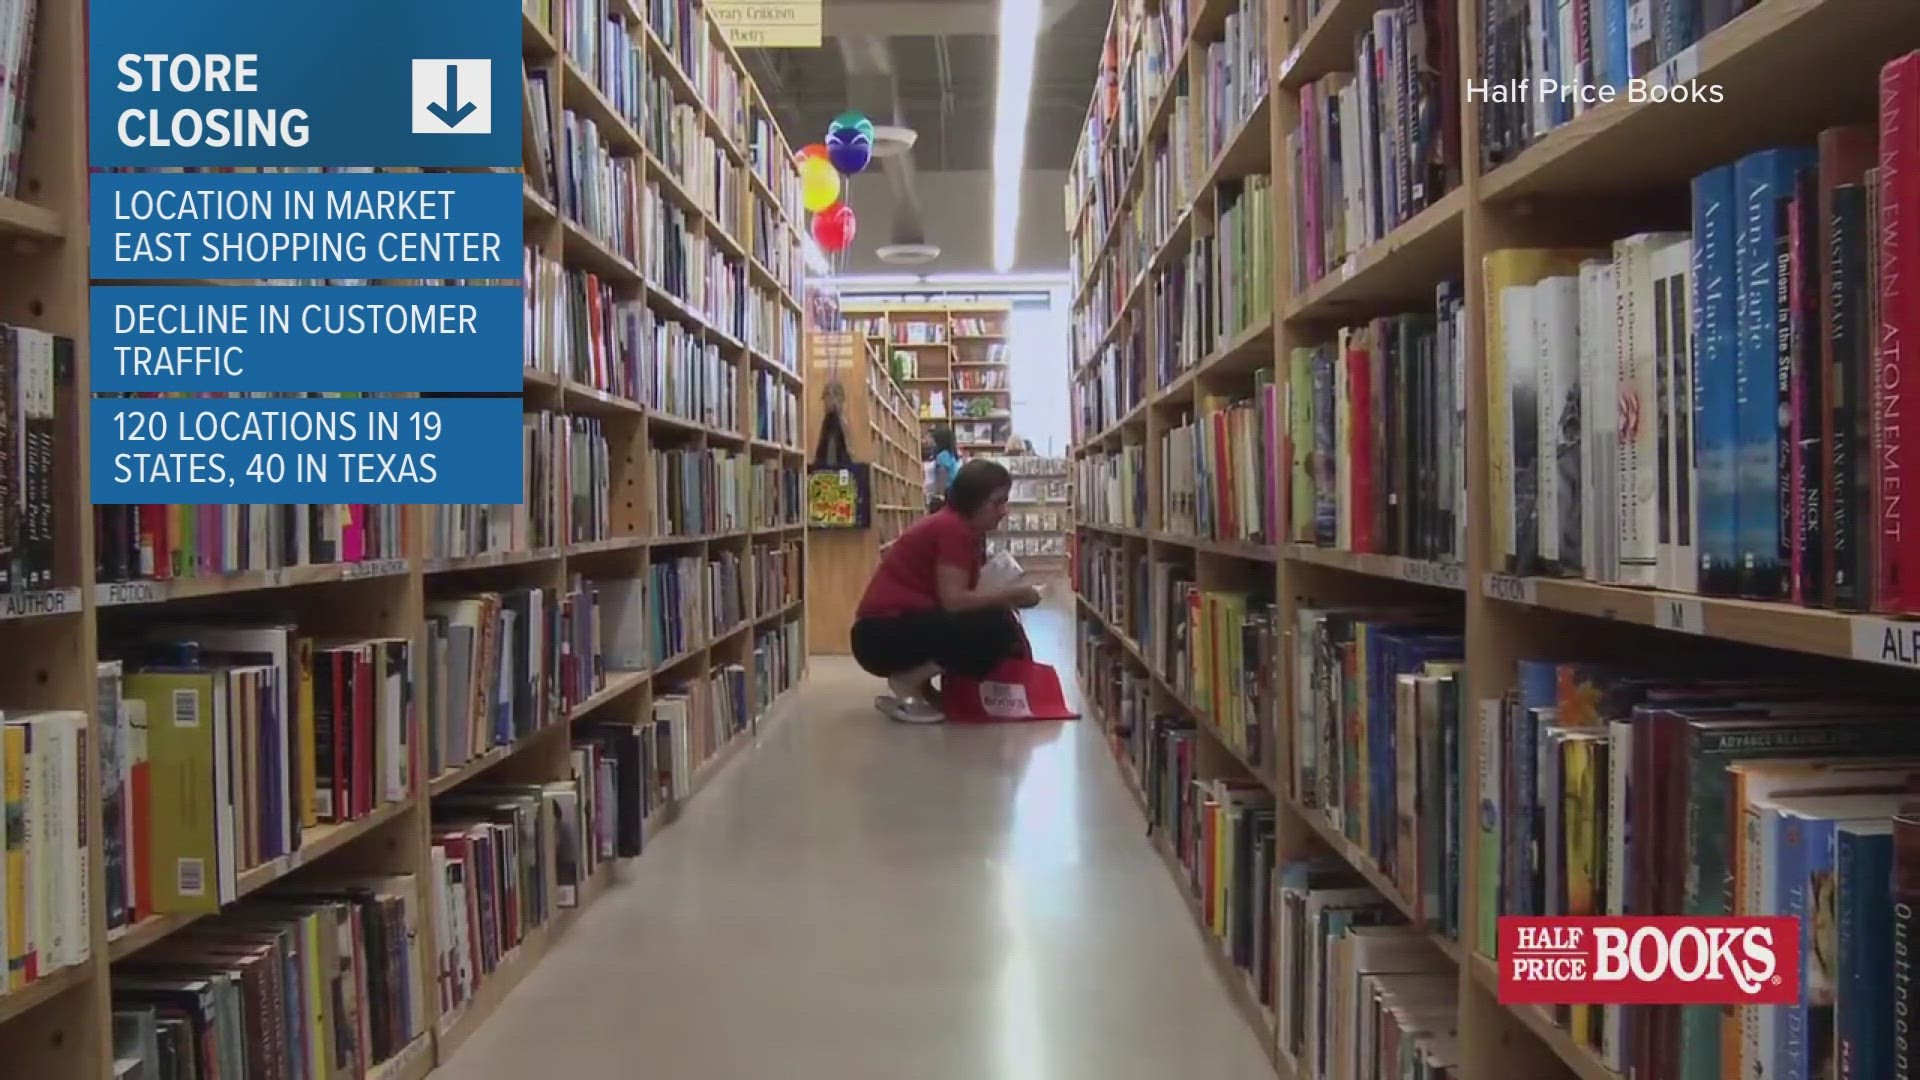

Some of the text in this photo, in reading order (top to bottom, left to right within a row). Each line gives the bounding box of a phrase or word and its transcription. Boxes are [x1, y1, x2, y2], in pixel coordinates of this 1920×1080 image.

[730, 28, 765, 43] Poetry
[1706, 202, 1722, 361] Ann-Marie
[1749, 183, 1770, 350] Ann-Marie
[1832, 213, 1844, 341] AMSTERDAM
[1778, 252, 1791, 393] Onions in the Stew
[1883, 323, 1901, 542] ATONEMENT
[1808, 487, 1819, 531] NICK
[6, 593, 65, 615] AUTHOR
[109, 583, 153, 602] FICTION
[1490, 576, 1525, 600] FICTION
[1671, 604, 1683, 627] M
